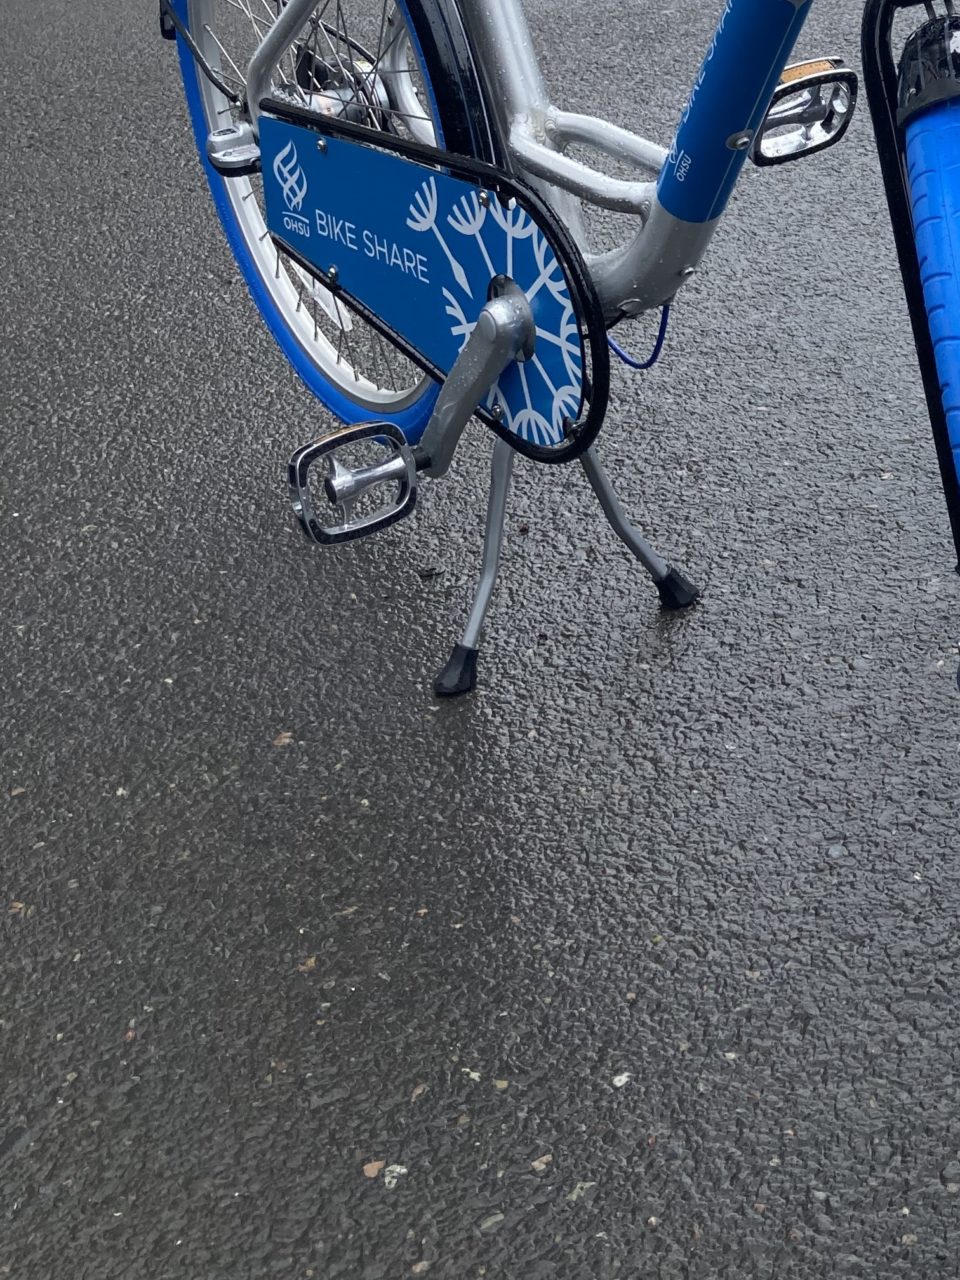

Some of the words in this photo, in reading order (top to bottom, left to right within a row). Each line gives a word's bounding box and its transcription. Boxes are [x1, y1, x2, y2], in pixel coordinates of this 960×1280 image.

[676, 154, 692, 183] OHSU
[283, 216, 311, 238] OHSU
[315, 209, 359, 251] BIKE
[362, 229, 430, 284] SHARE
